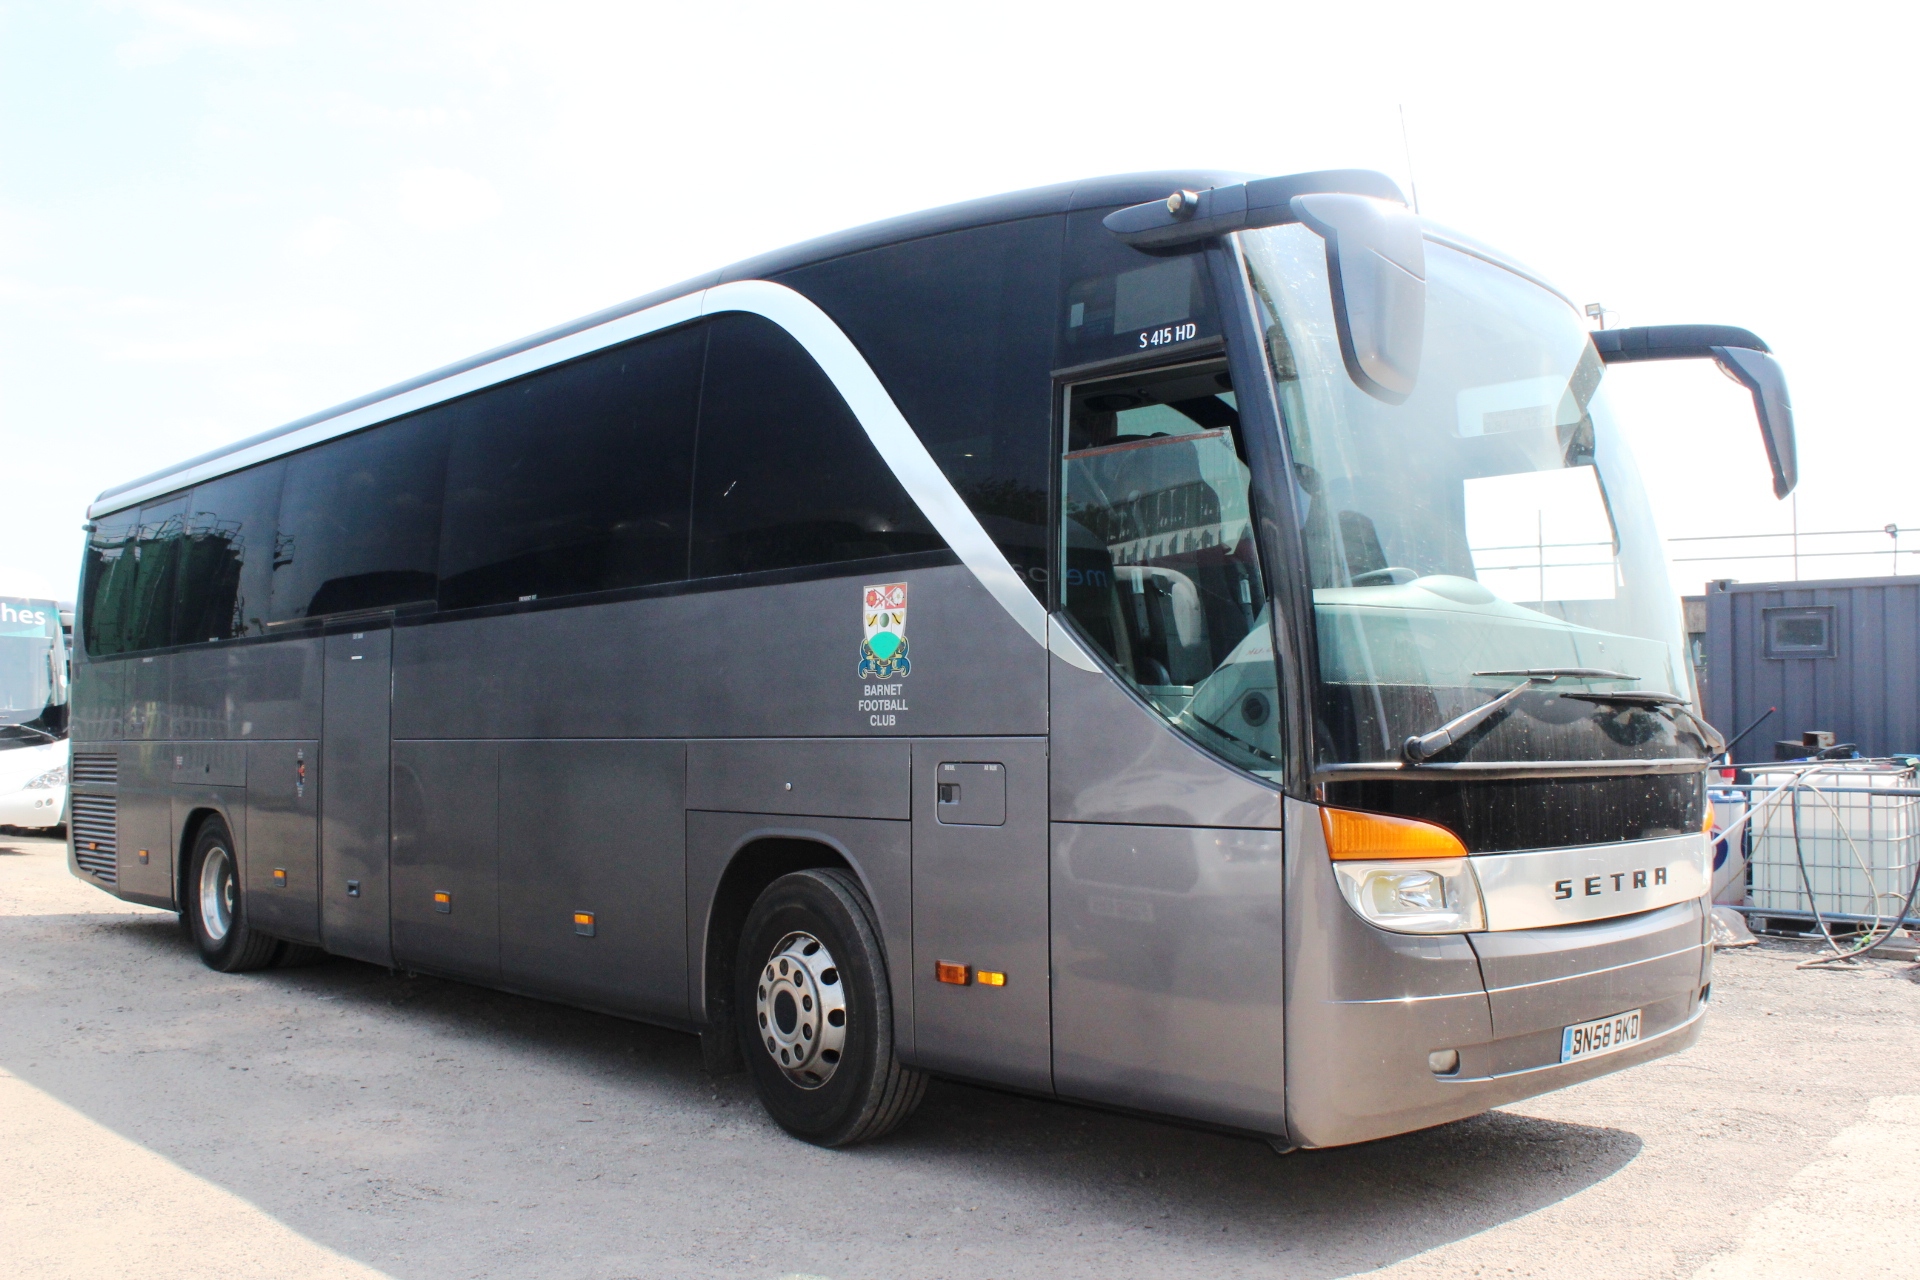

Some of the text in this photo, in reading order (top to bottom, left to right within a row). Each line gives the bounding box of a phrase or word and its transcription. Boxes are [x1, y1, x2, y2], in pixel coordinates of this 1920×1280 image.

[1139, 323, 1196, 348] S 415 HD
[864, 684, 903, 696] BARNET
[858, 699, 909, 711] FOOTBALL
[869, 714, 896, 726] CLUB
[1554, 866, 1667, 901] SETRA
[1573, 1014, 1638, 1055] BN58 BKD
